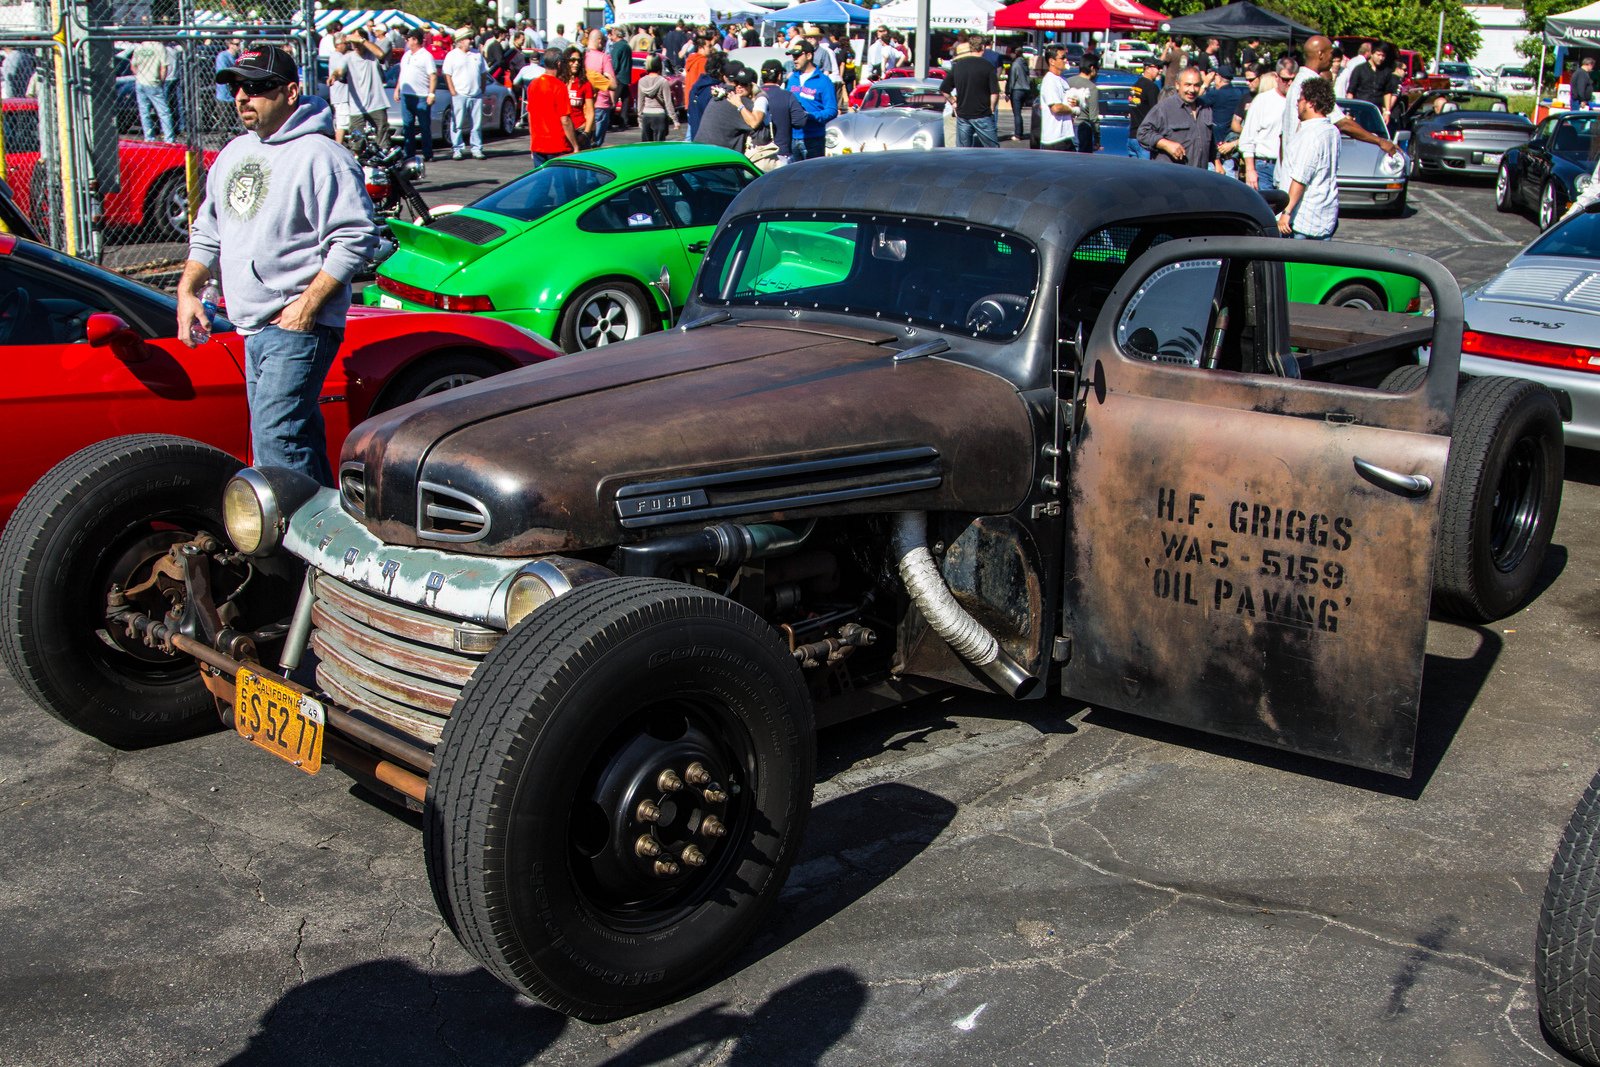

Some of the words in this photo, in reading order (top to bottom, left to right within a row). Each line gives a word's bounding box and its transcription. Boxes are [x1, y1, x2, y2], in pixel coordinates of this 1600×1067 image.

[930, 16, 967, 24] ALLERY
[637, 495, 691, 512] FORD
[1157, 487, 1214, 529] H.F.
[1229, 501, 1353, 551] GRIGGS
[318, 534, 447, 591] FORD
